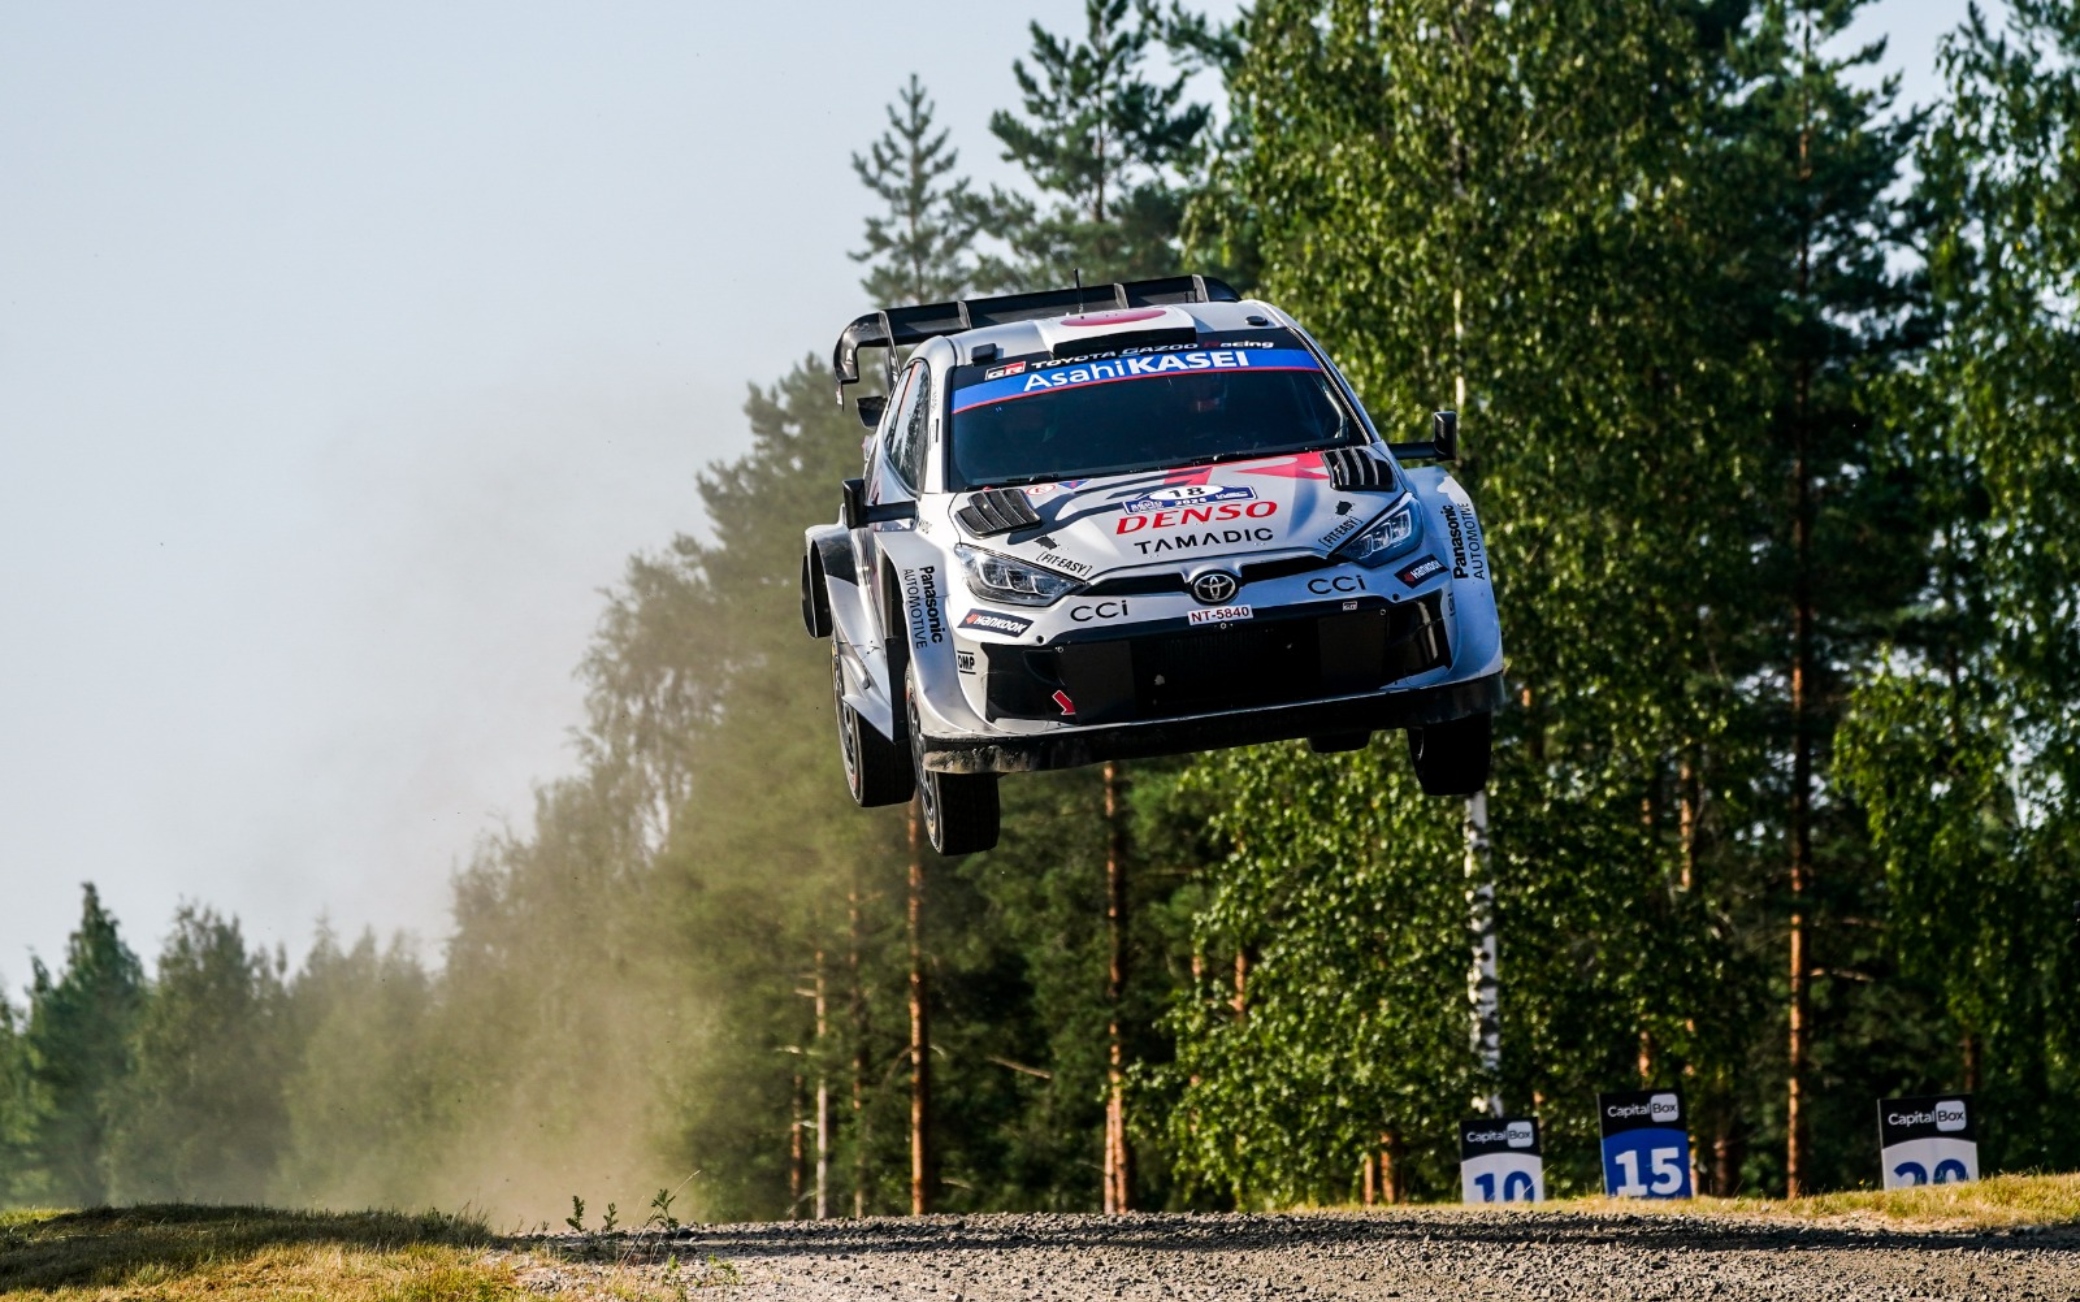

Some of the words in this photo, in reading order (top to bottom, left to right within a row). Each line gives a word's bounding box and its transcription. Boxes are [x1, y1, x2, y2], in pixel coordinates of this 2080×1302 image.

[1031, 350, 1116, 369] TOYOTA
[1119, 343, 1198, 358] GAZOO
[1168, 487, 1206, 498] 18
[1116, 501, 1278, 535] DENSO
[1134, 528, 1274, 555] TAMADIC
[1440, 504, 1469, 580] Panasonic
[1457, 502, 1485, 581] AUTOMOTIVE
[902, 568, 928, 649] AUTOMOTIVE
[919, 565, 946, 644] Panasonic
[1190, 606, 1250, 624] NT-5840
[957, 654, 976, 671] OMP
[1474, 1170, 1535, 1202] 10
[1615, 1147, 1683, 1196] 15
